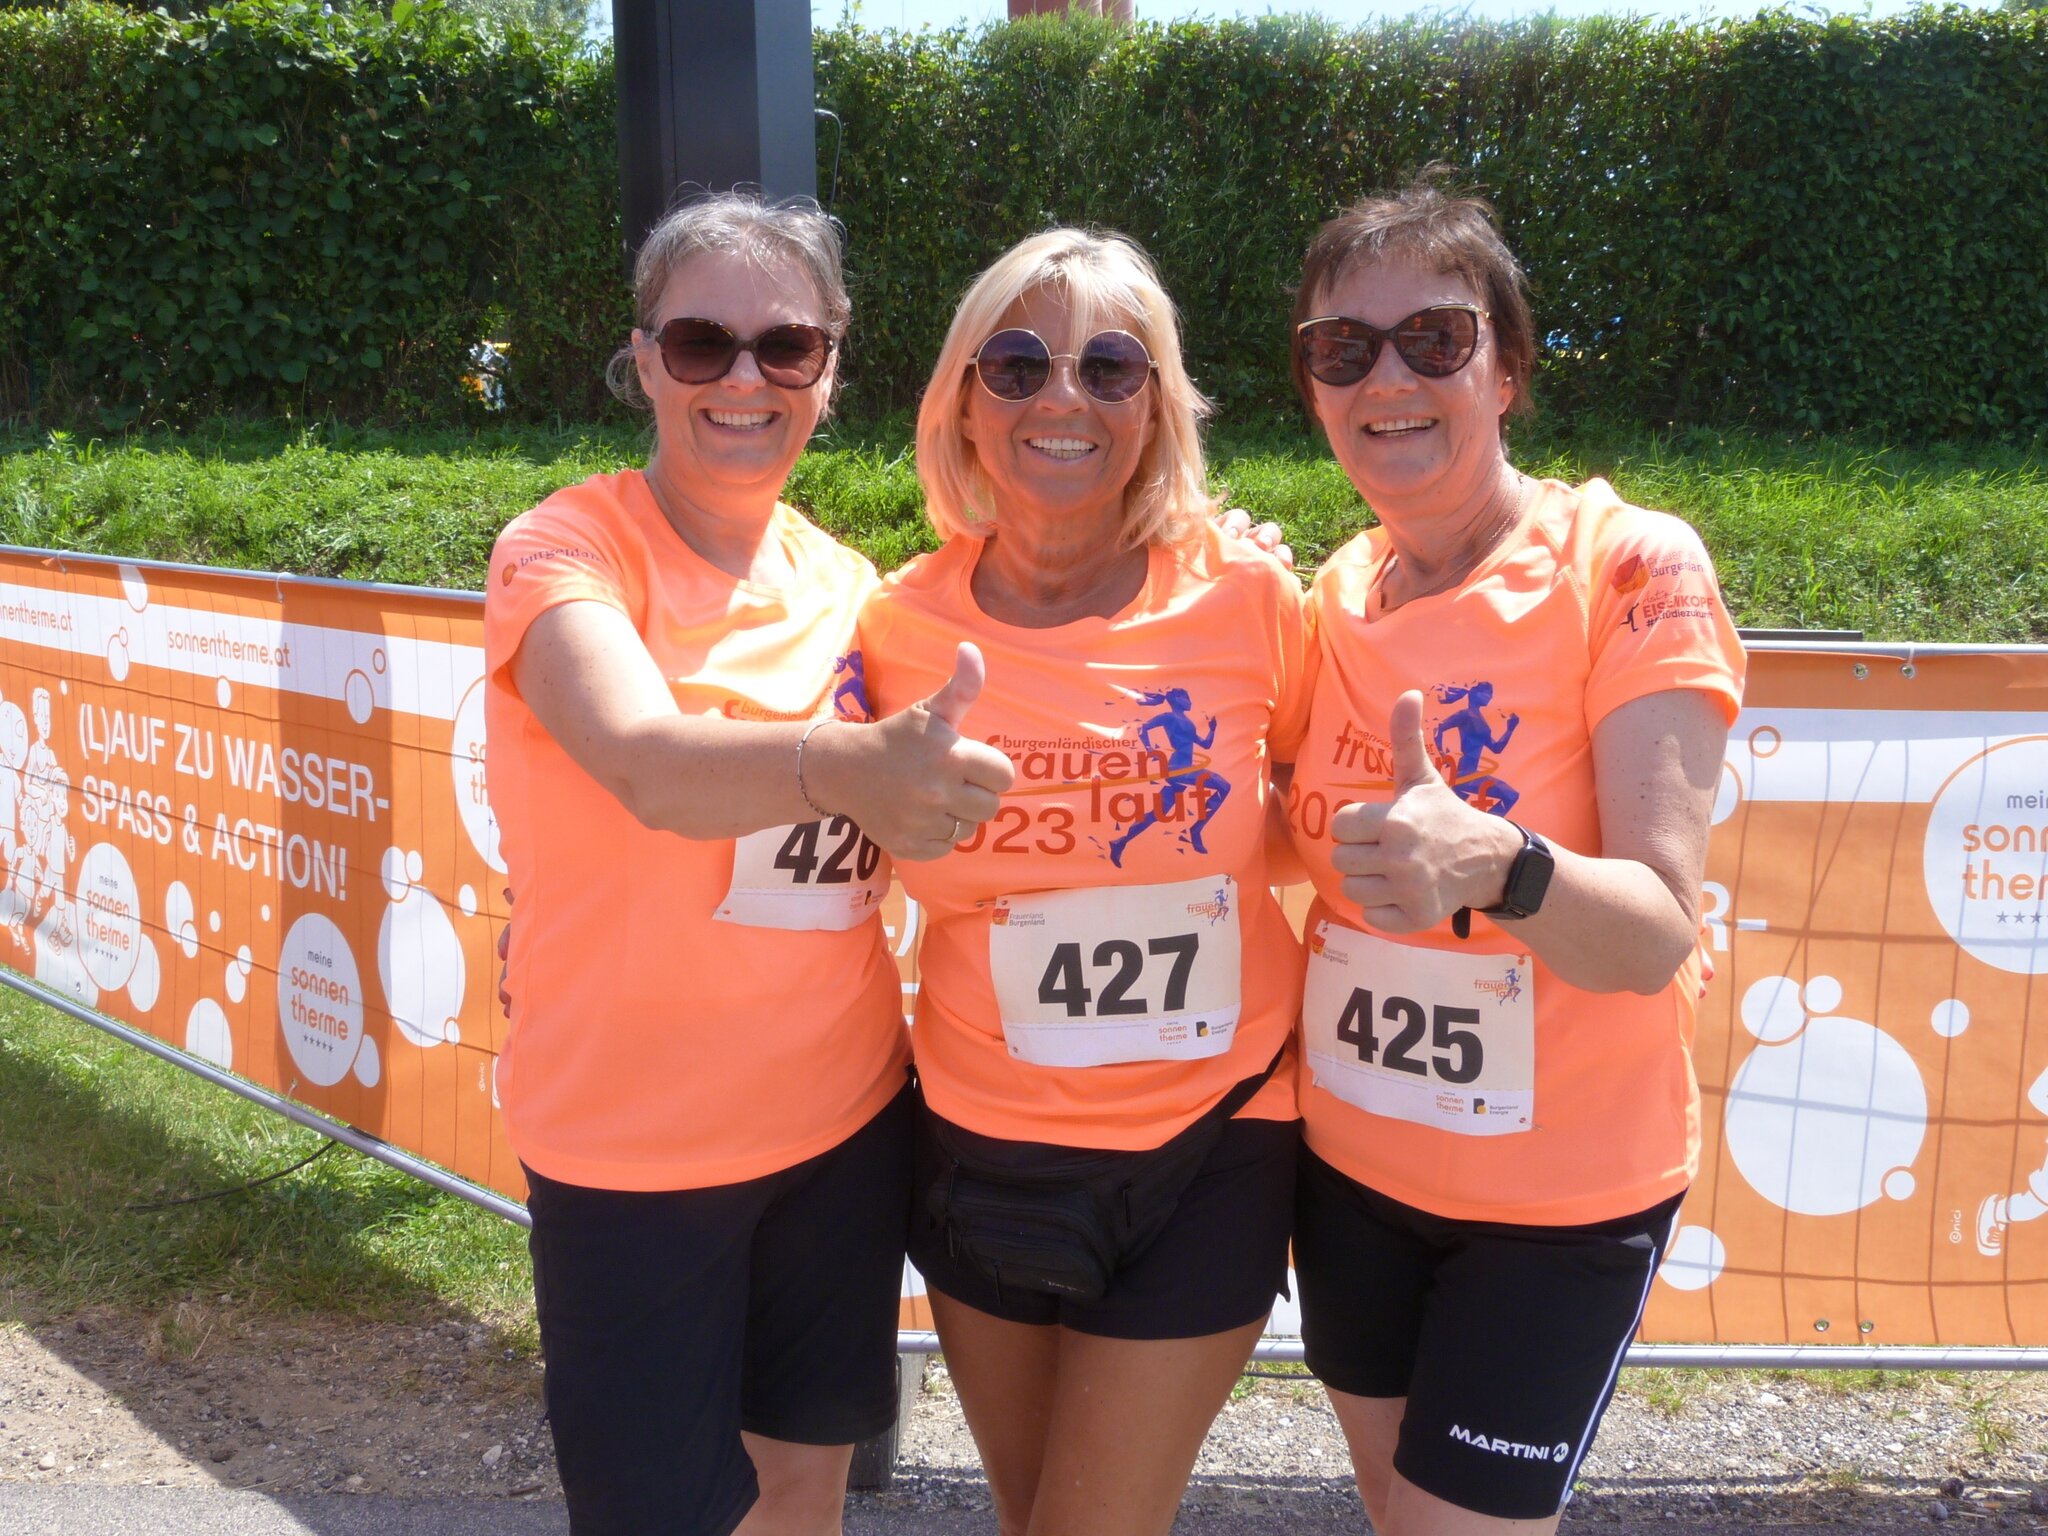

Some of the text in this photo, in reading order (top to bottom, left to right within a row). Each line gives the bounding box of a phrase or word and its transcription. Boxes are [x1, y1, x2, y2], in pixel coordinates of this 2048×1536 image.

[168, 630, 290, 668] sonnentherme.at
[1003, 735, 1138, 751] burgenländischer
[79, 703, 389, 822] (L)AUF ZU WASSER-
[1091, 773, 1211, 823] lauf
[2007, 790, 2048, 809] mei
[82, 775, 346, 900] SPASS & ACTION!
[87, 890, 129, 920] sonnen
[86, 912, 129, 950] therme
[308, 951, 332, 968] meine
[1038, 933, 1199, 1017] 427
[292, 966, 348, 1006] sonnen
[291, 993, 348, 1040] therme
[1158, 1025, 1187, 1033] sonnen
[1159, 1033, 1187, 1041] therme
[1337, 987, 1484, 1084] 425
[1436, 1095, 1464, 1104] sonnen
[1436, 1102, 1464, 1112] therme
[1449, 1424, 1550, 1460] MARTINI
